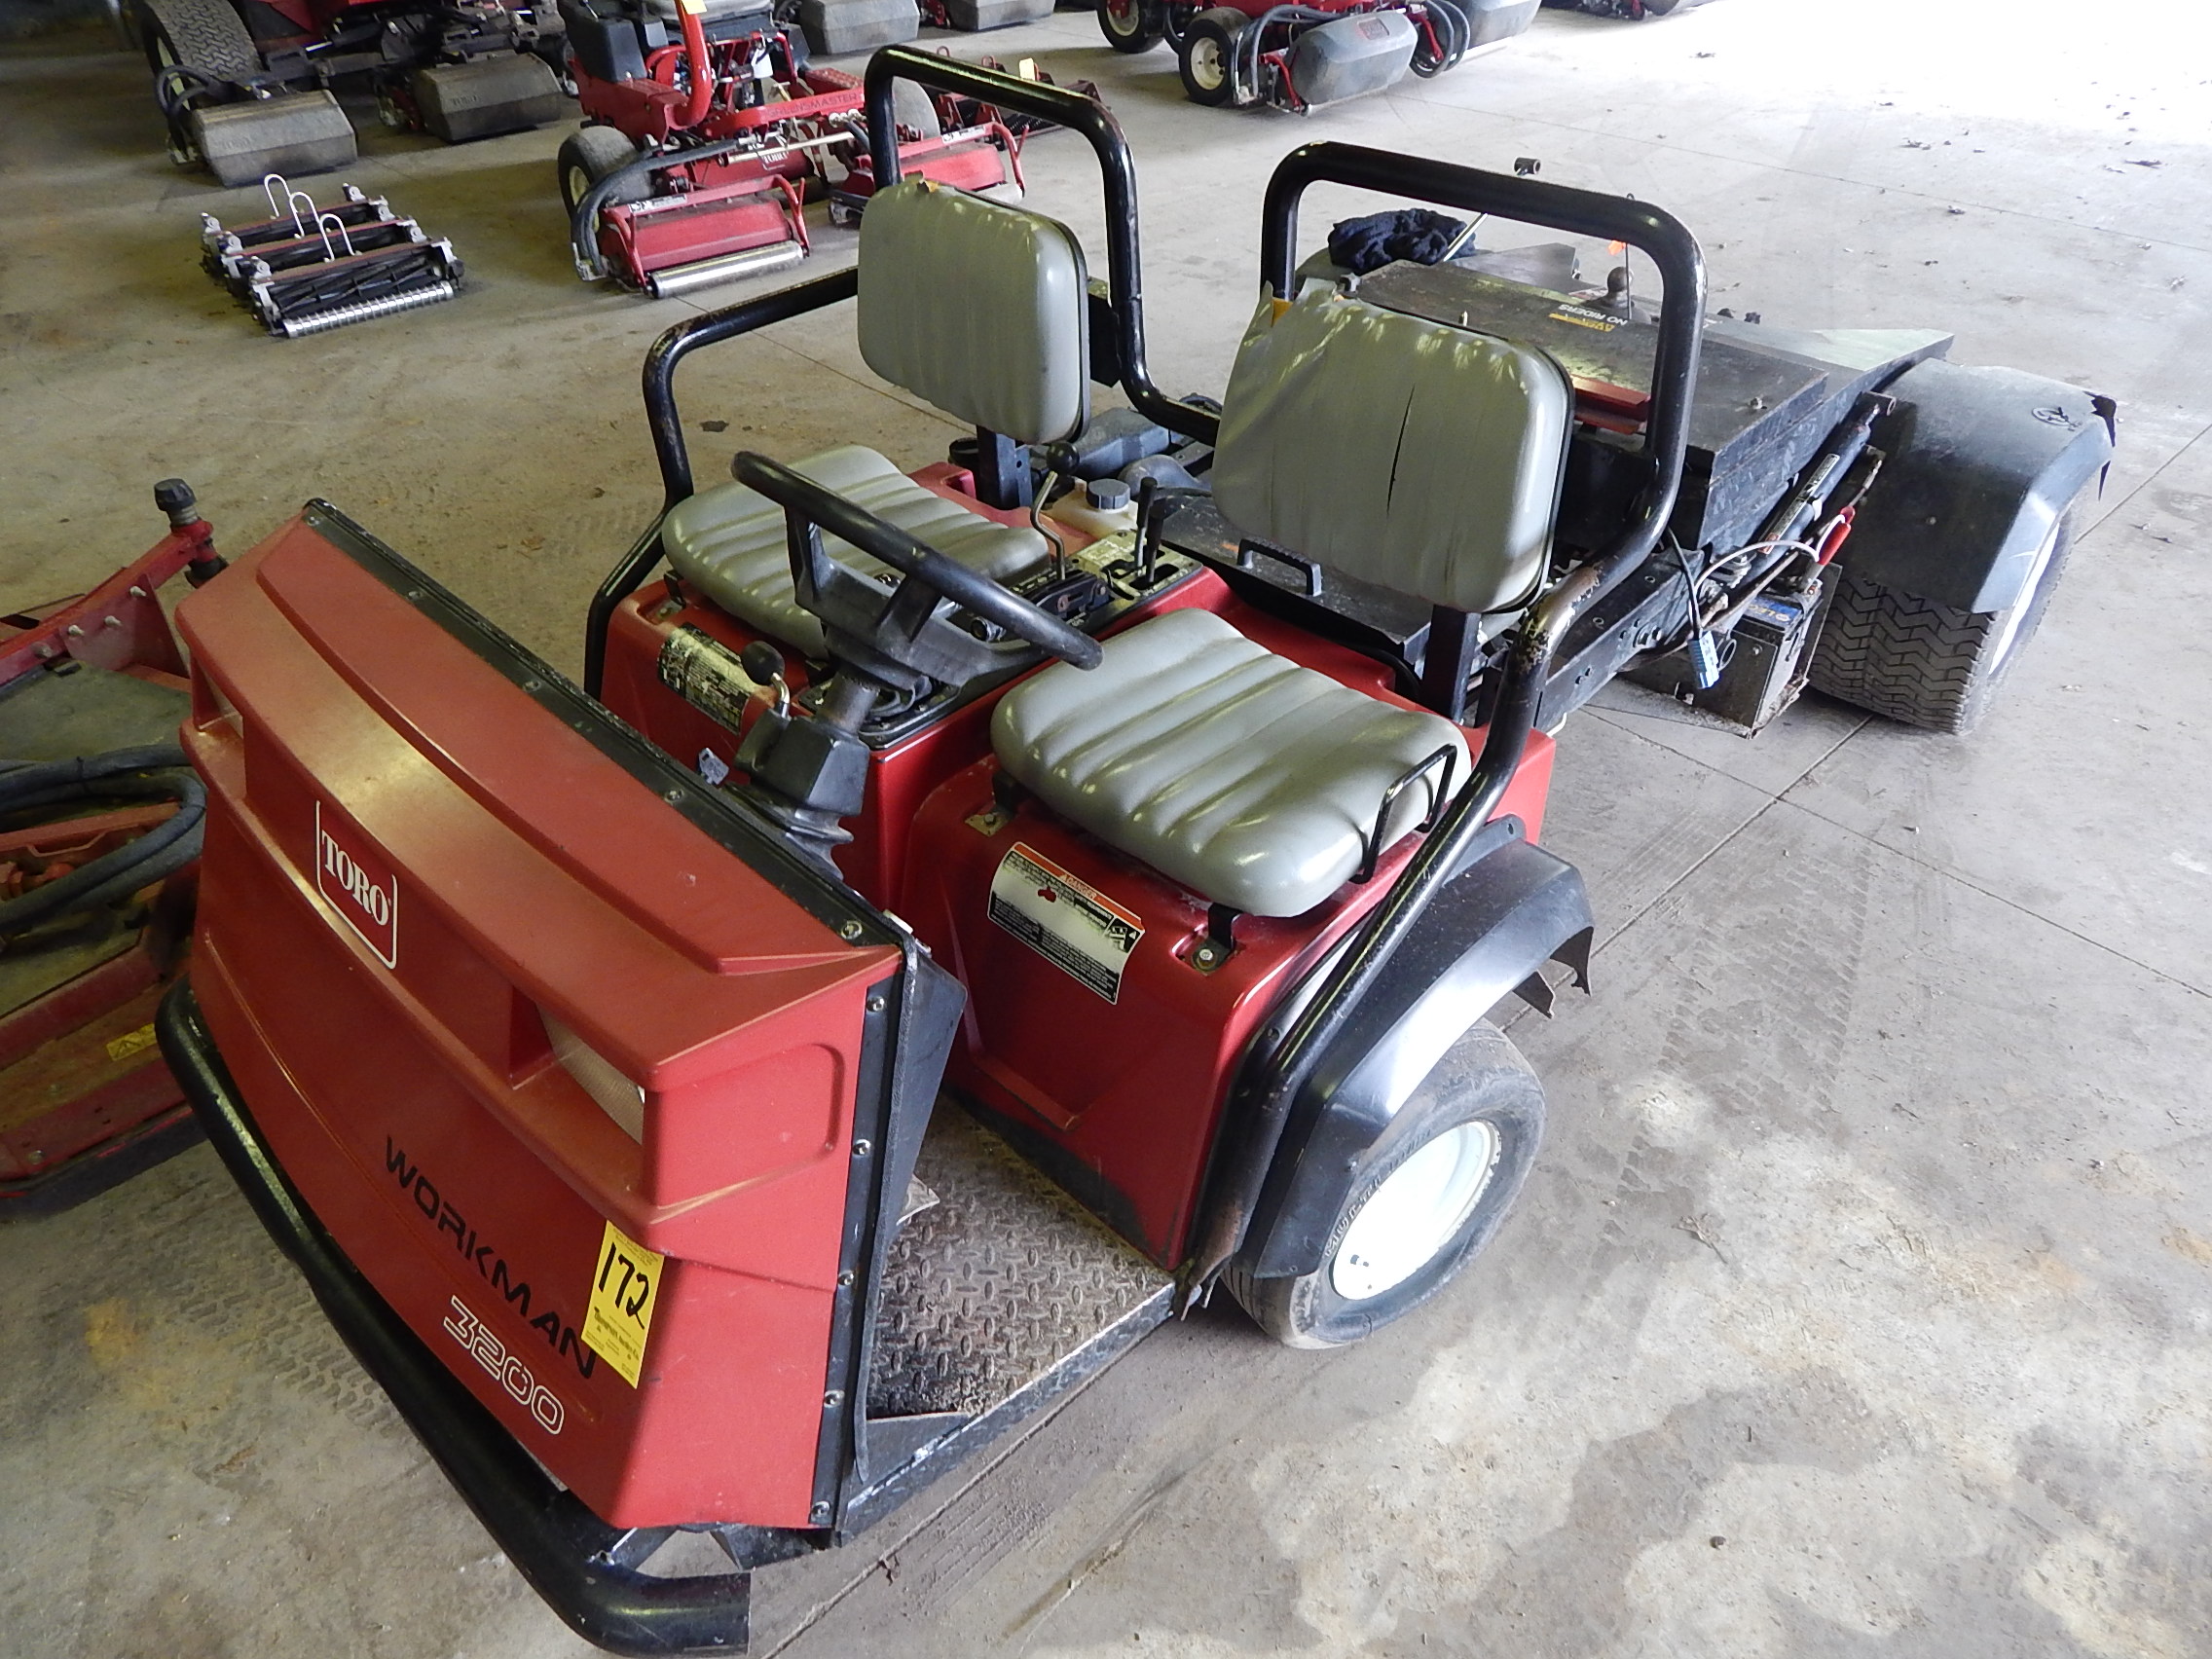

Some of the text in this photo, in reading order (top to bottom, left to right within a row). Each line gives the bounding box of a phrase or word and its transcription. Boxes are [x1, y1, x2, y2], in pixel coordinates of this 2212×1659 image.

[1558, 304, 1606, 320] RIDERS
[1606, 315, 1628, 326] NO
[321, 830, 389, 926] TORO
[387, 1133, 596, 1379] WORKMAN
[598, 1241, 645, 1331] 172
[443, 1294, 565, 1435] 3200
